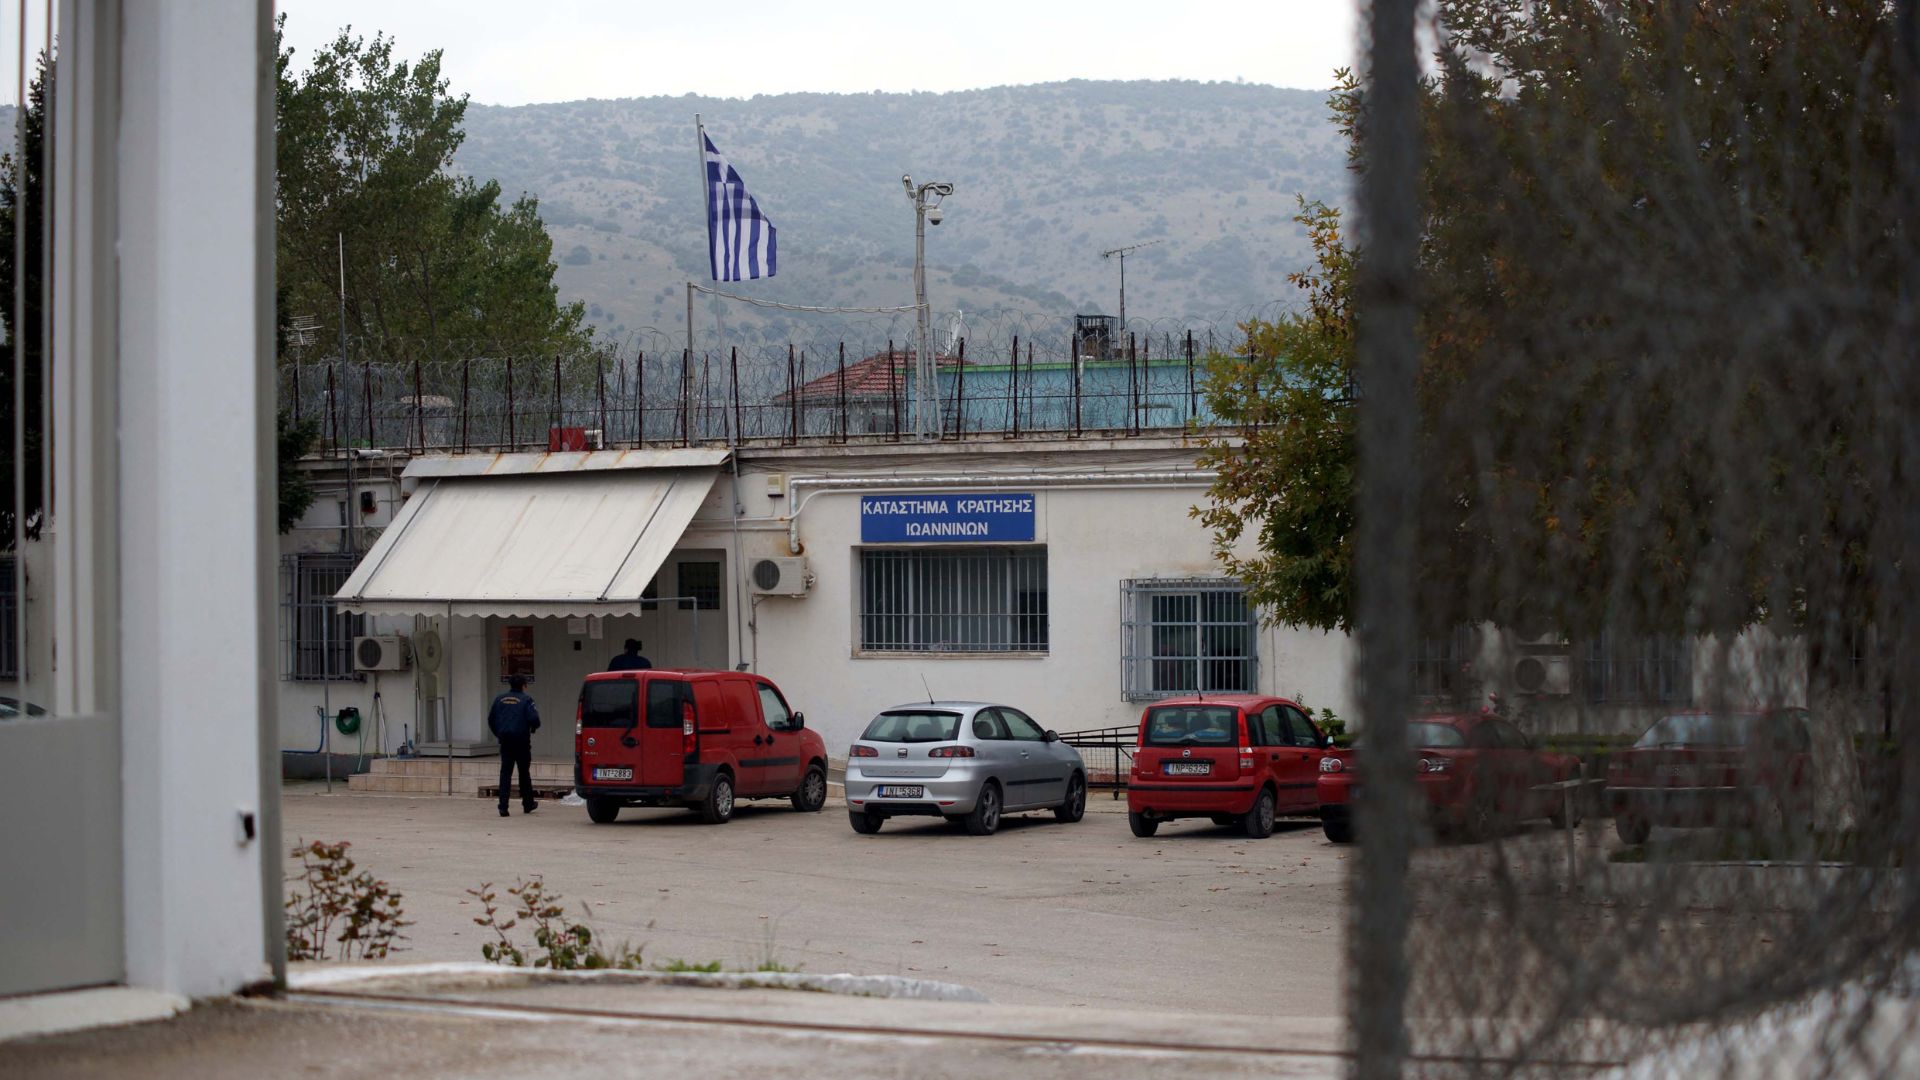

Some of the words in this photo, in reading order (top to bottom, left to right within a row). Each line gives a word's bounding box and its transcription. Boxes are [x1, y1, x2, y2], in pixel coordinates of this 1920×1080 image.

[863, 501, 949, 514] ΚΑΤΑΣΤΗΜΑ
[957, 499, 1032, 513] ΚΡΑΤΗΣΗΣ
[906, 522, 988, 536] ΙΩΑΝΝΙΝΩΝ
